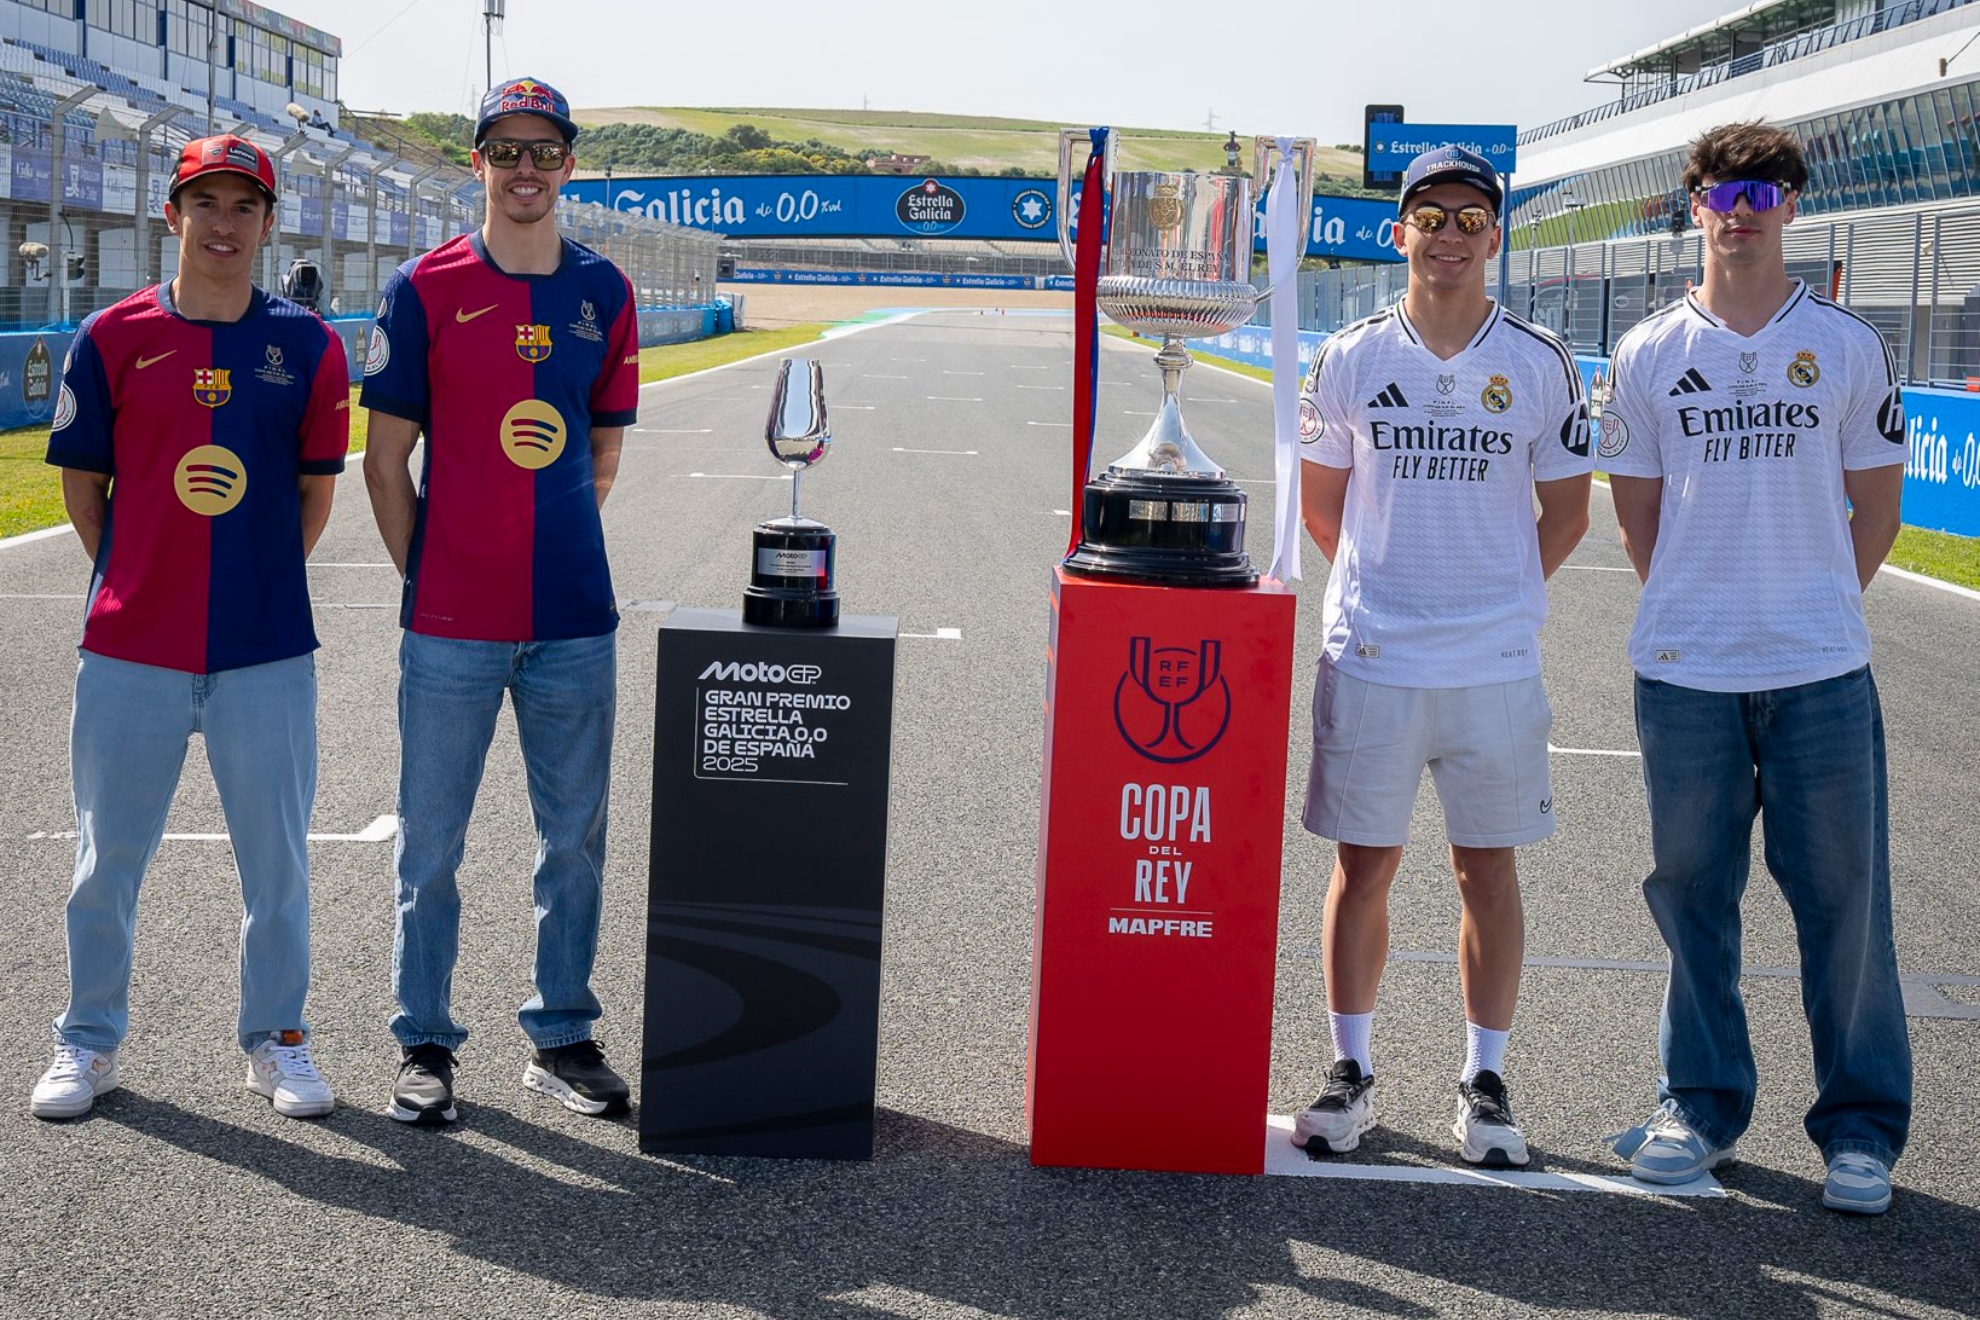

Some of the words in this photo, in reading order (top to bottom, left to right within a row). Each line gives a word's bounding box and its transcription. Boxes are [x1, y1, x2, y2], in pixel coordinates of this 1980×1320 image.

[500, 95, 529, 112] Red
[530, 95, 556, 113] Bull
[229, 147, 256, 161] Lenovo
[1390, 140, 1437, 154] Estrella
[1426, 160, 1481, 173] TRACKHOUSE
[614, 188, 747, 228] Galicia
[776, 190, 818, 222] 0,0
[908, 194, 954, 207] Estrella
[909, 207, 951, 220] Galicia
[1678, 400, 1820, 437] Emirates
[1370, 419, 1513, 454] Emirates
[1703, 437, 1731, 463] FLY
[1739, 433, 1796, 460] BTTER
[1393, 455, 1422, 479] FLY
[1427, 456, 1489, 482] BETTER
[698, 661, 822, 684] MotoGP
[705, 690, 761, 706] GRAN
[766, 692, 851, 710] PREMIO
[705, 706, 803, 725] ESTRELLA
[704, 723, 790, 741] GALICIA
[704, 739, 731, 755] DE
[734, 739, 815, 759] ESPAÑA
[702, 755, 759, 772] 2025
[1120, 783, 1211, 842] COPA
[1149, 846, 1182, 856] DEL
[1134, 859, 1192, 904] REY
[1108, 917, 1213, 938] MAPFRE
